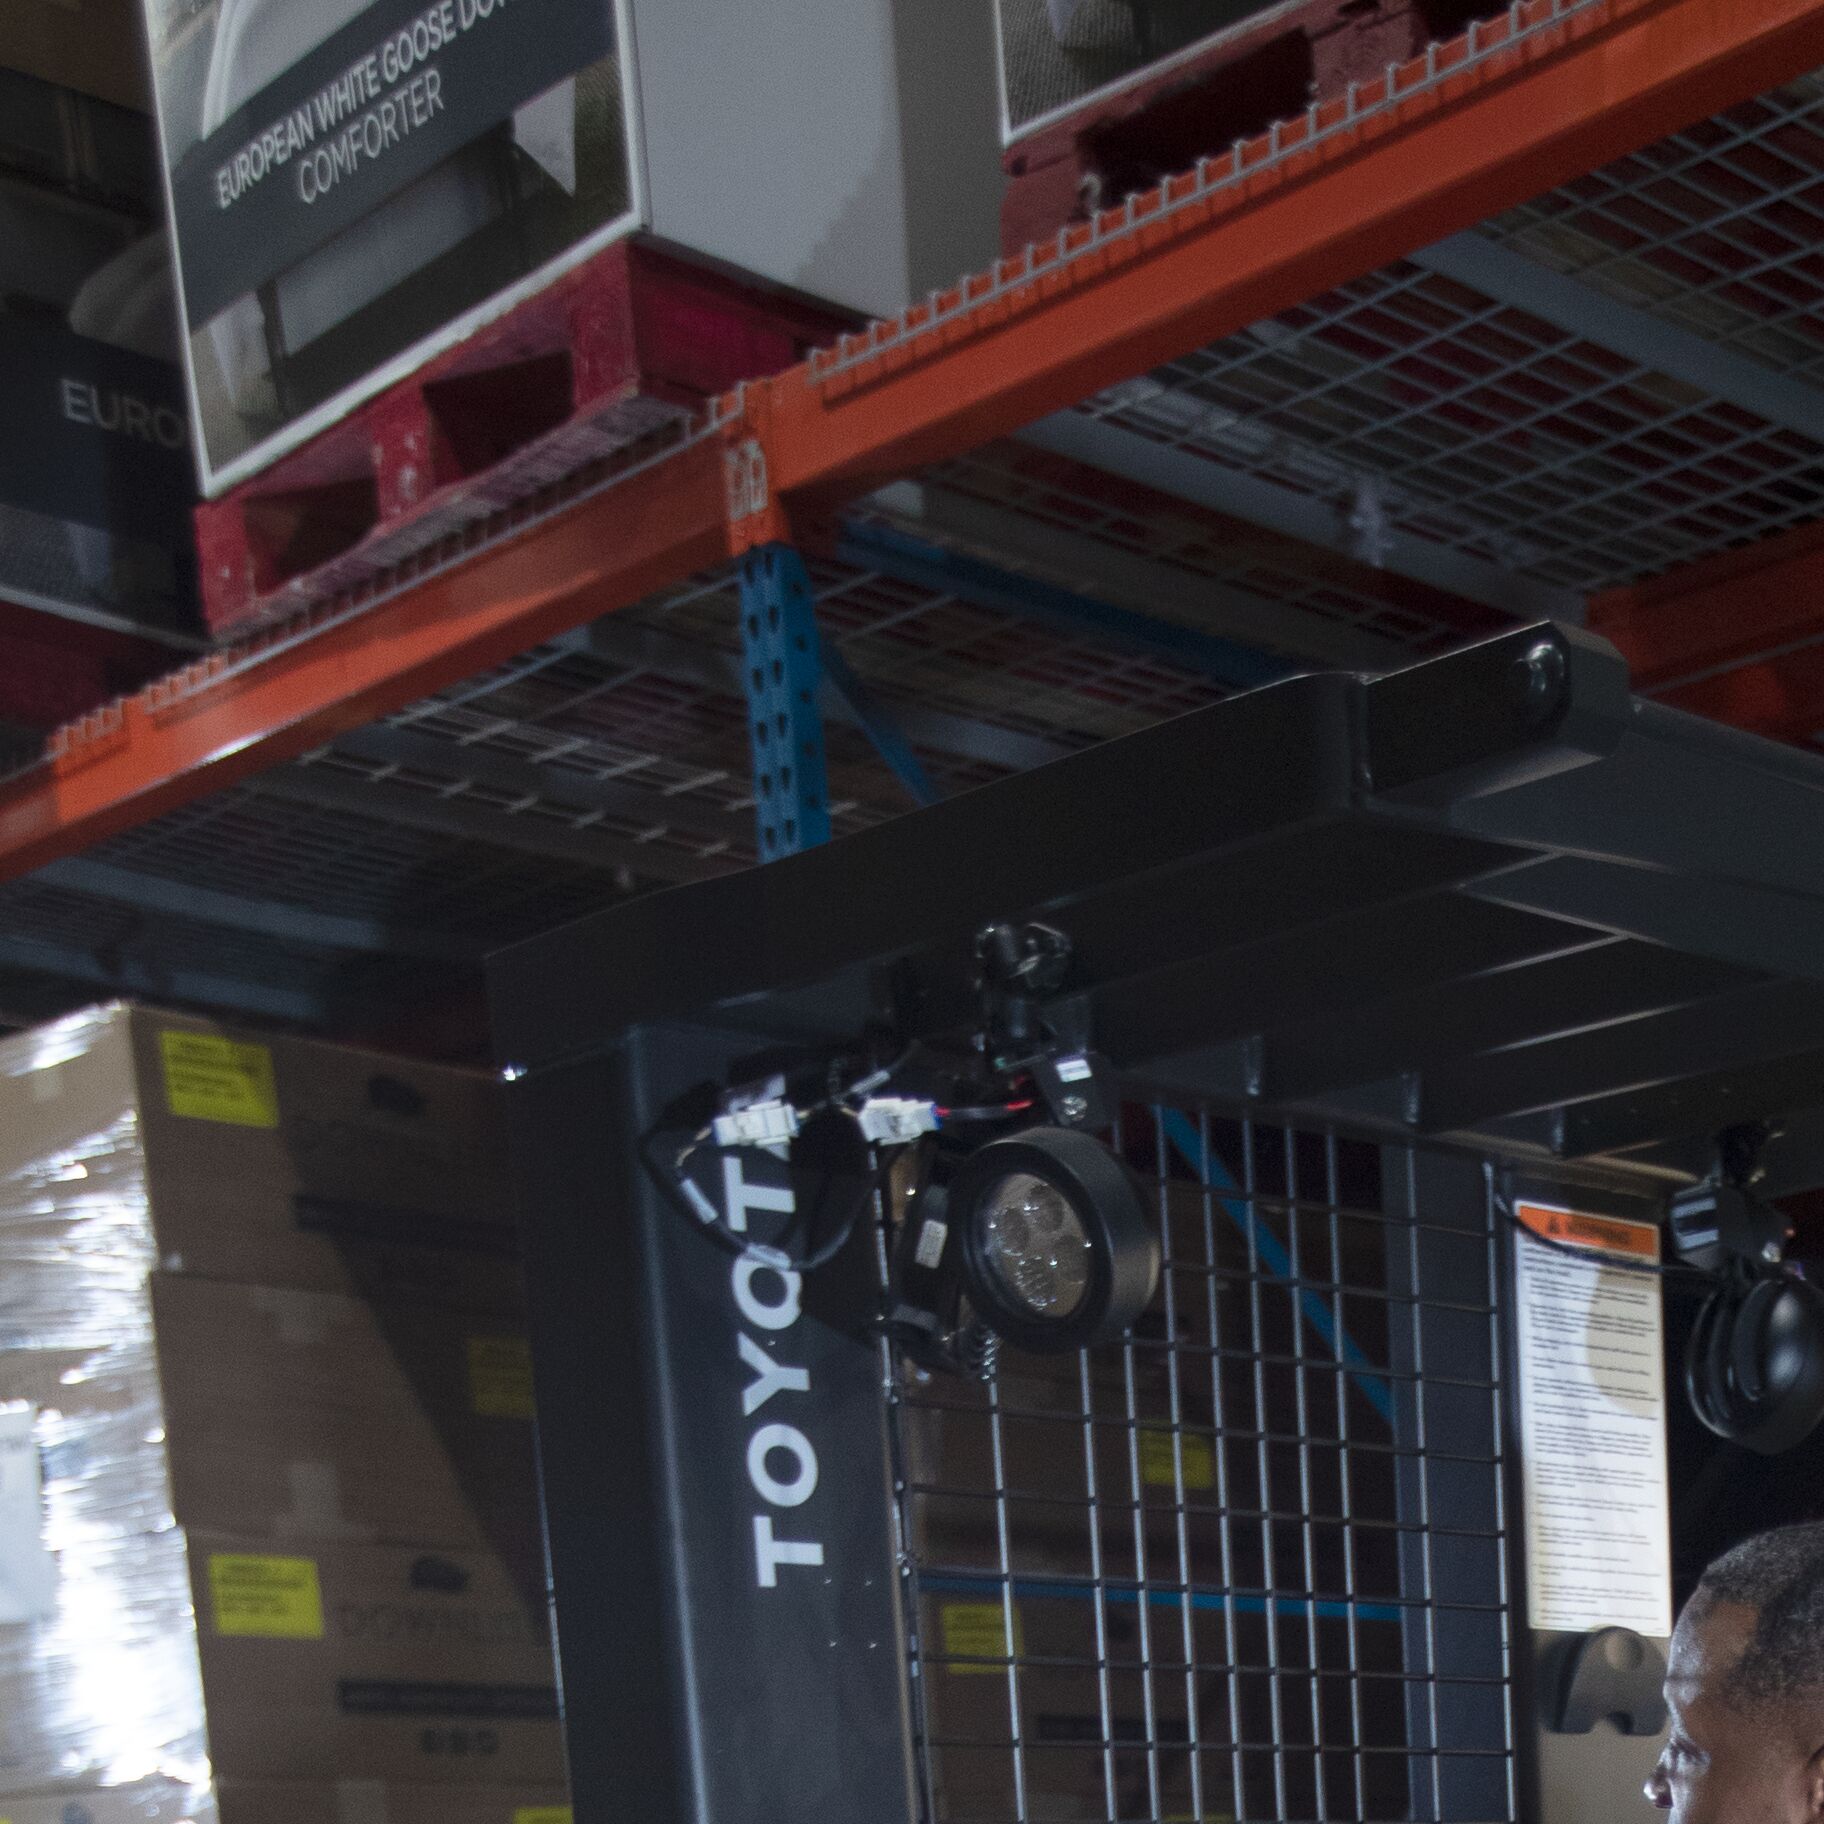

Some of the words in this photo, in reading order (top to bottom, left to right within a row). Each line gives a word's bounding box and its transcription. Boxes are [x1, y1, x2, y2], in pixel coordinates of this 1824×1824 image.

[215, 110, 315, 209] EUROPEAN
[313, 54, 382, 132] WHITE
[381, 2, 458, 84] GOOSE
[300, 67, 445, 205] COMFORTER
